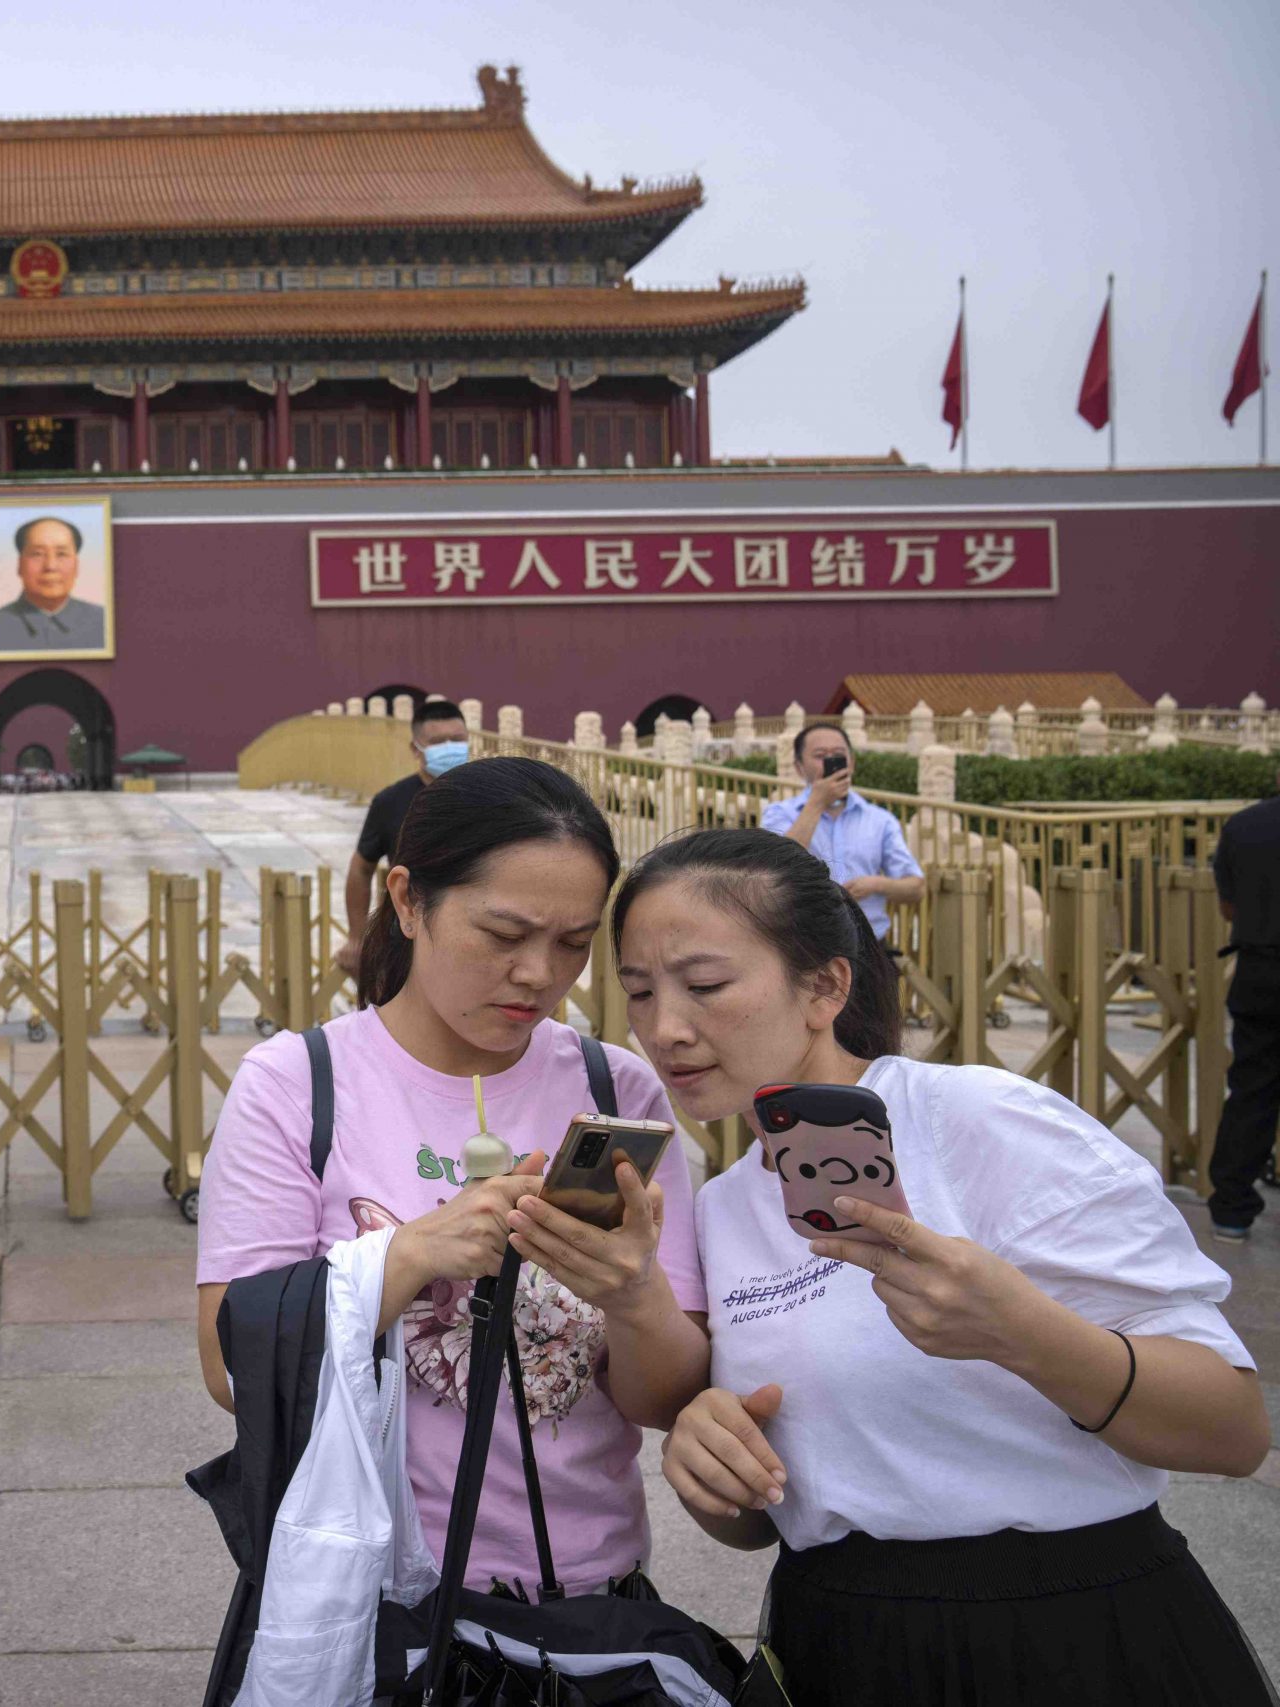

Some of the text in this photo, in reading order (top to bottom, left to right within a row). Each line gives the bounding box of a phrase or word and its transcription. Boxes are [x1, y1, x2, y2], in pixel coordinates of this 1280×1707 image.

[353, 533, 1018, 593] 世界人民大团结万岁
[749, 1276, 767, 1284] met
[770, 1268, 794, 1282] lovely
[805, 1255, 822, 1270] peop
[730, 1286, 826, 1326] AUGUST 20 & 98
